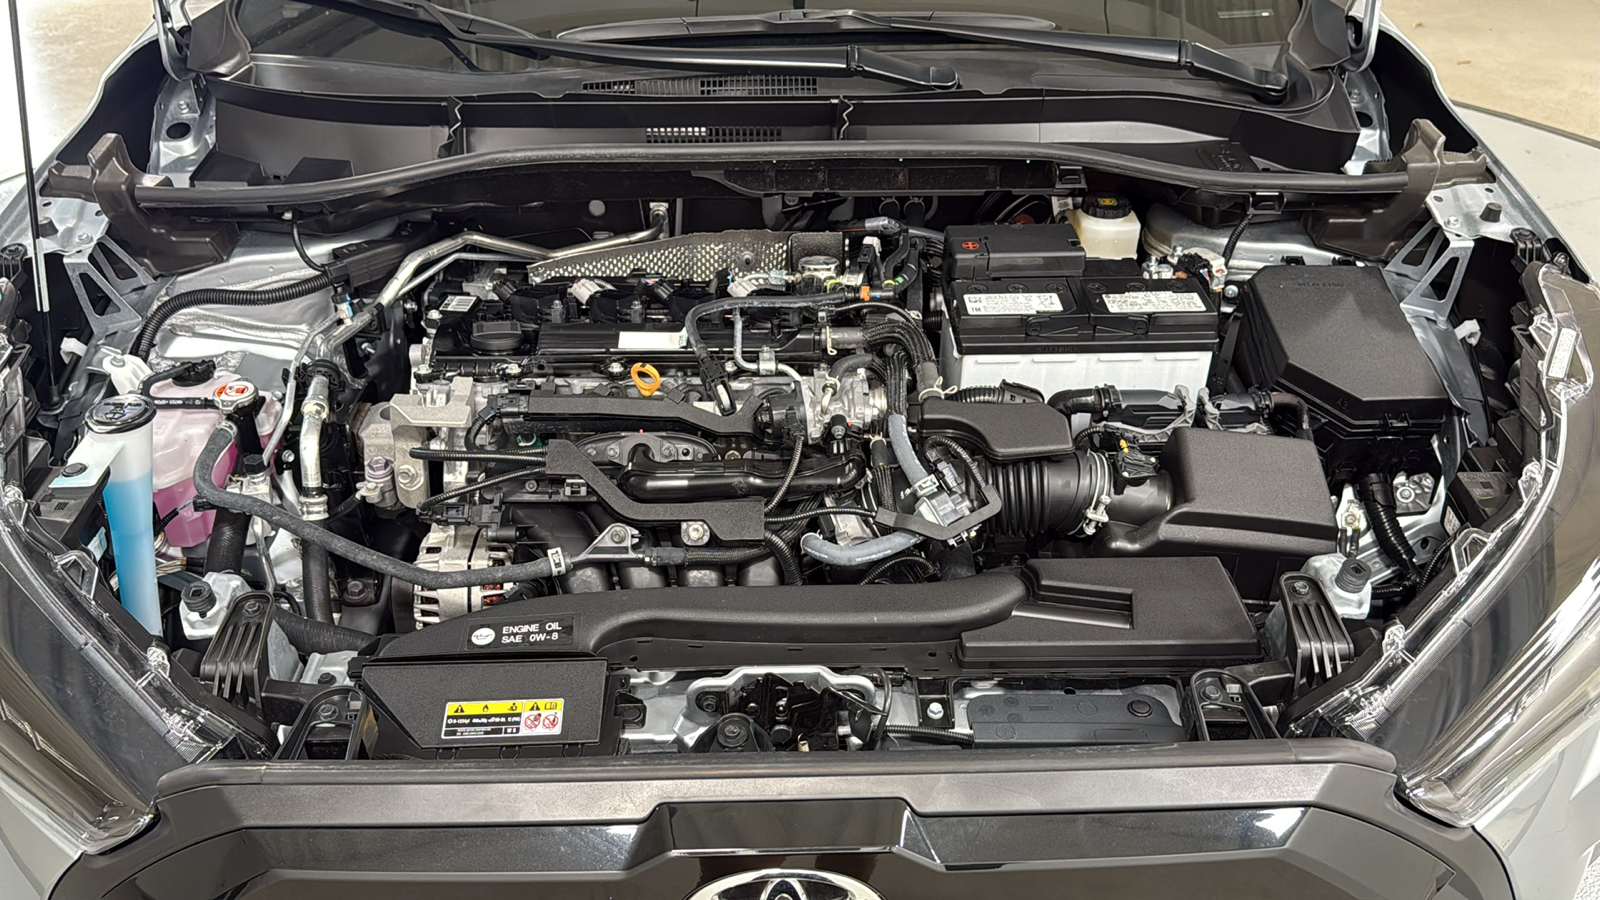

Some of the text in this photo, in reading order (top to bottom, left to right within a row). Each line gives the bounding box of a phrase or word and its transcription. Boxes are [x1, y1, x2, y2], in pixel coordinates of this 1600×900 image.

[502, 621, 562, 635] ENGINE OIL
[501, 631, 559, 644] SAE 0W-8
